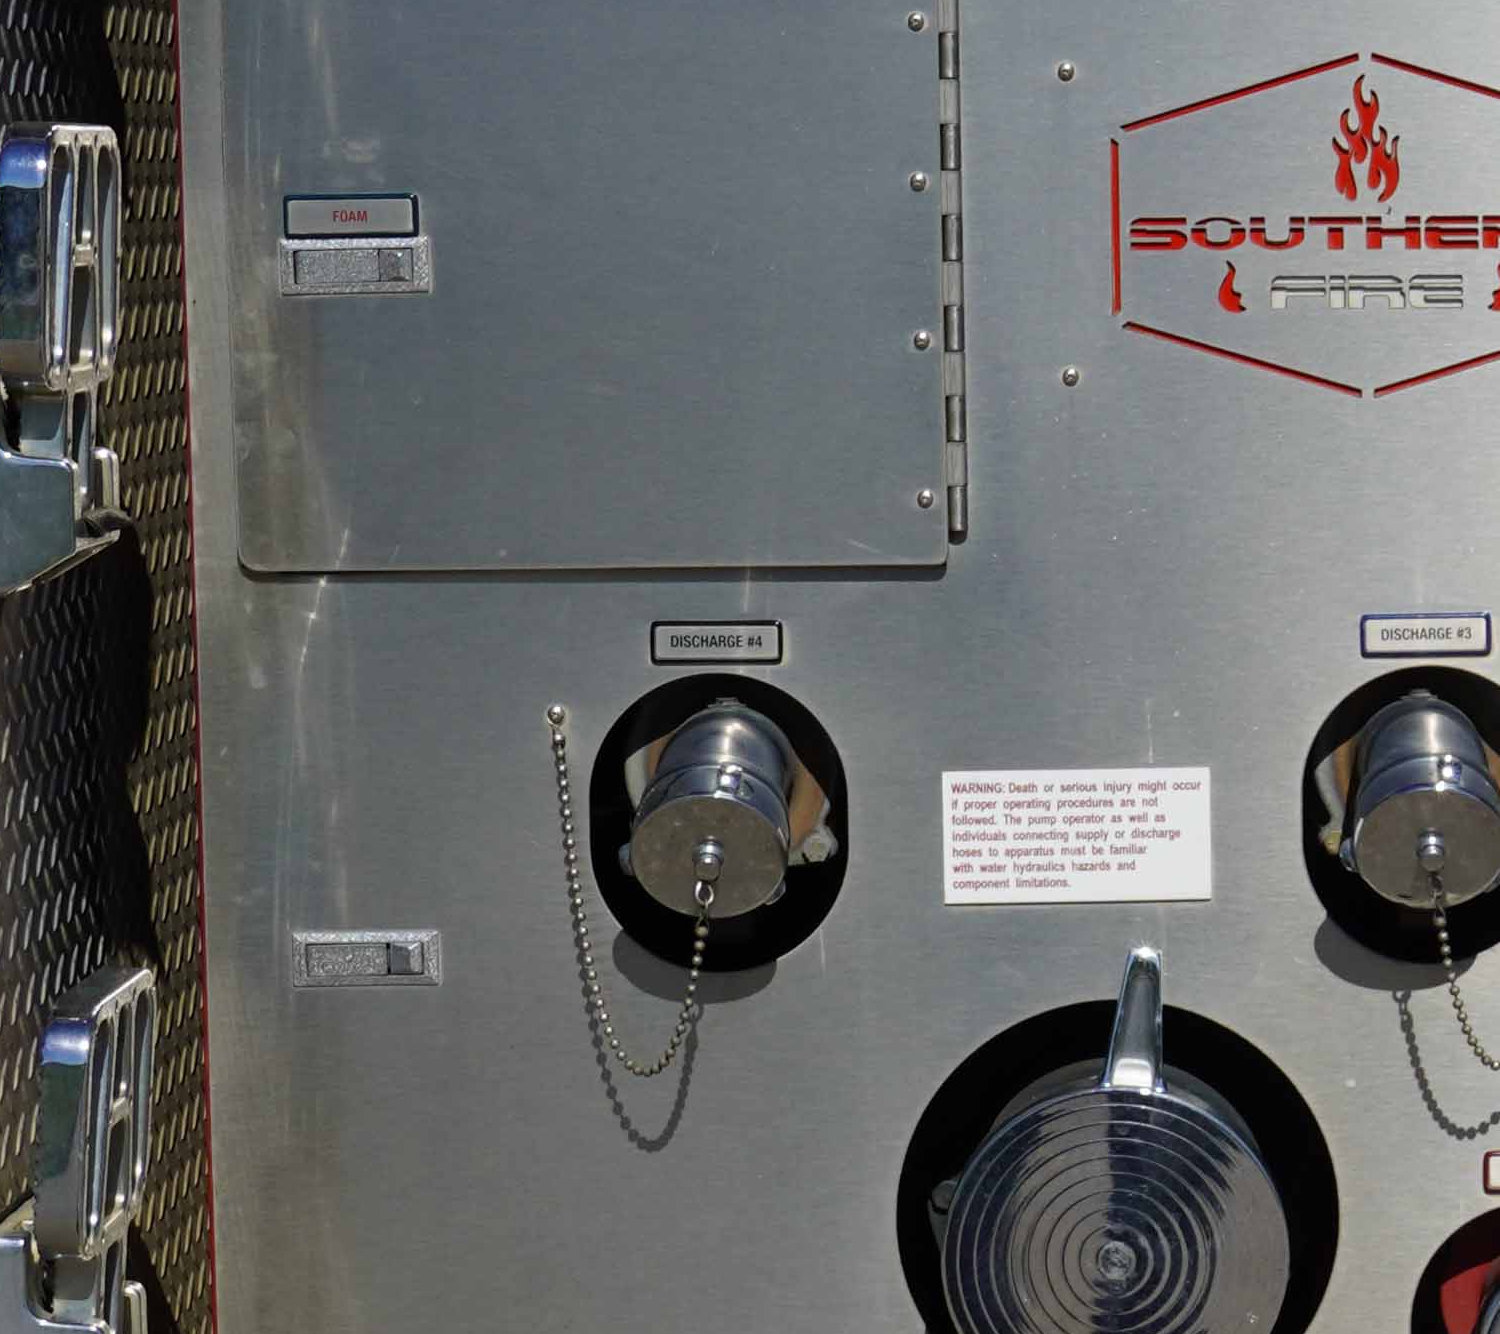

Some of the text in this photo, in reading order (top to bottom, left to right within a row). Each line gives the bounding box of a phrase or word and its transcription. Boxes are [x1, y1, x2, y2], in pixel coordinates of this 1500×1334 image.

[332, 210, 368, 223] FOAM
[1270, 273, 1464, 311] FIRE
[1381, 626, 1472, 641] DISCHARGE #3
[670, 635, 763, 648] DISCHARGE #4
[951, 781, 1201, 795] WARNING: Death or serious injury might occur
[951, 797, 1158, 812] if proper operating procedures are not
[952, 812, 1166, 826] followed. The pump operator as well as
[952, 828, 1181, 843] individuals connecting supply or discharge
[952, 844, 1147, 859] hoses to apparatus must be familiar
[953, 859, 1136, 875] with water hydraulics hazards and
[953, 878, 1071, 892] component limitations.
